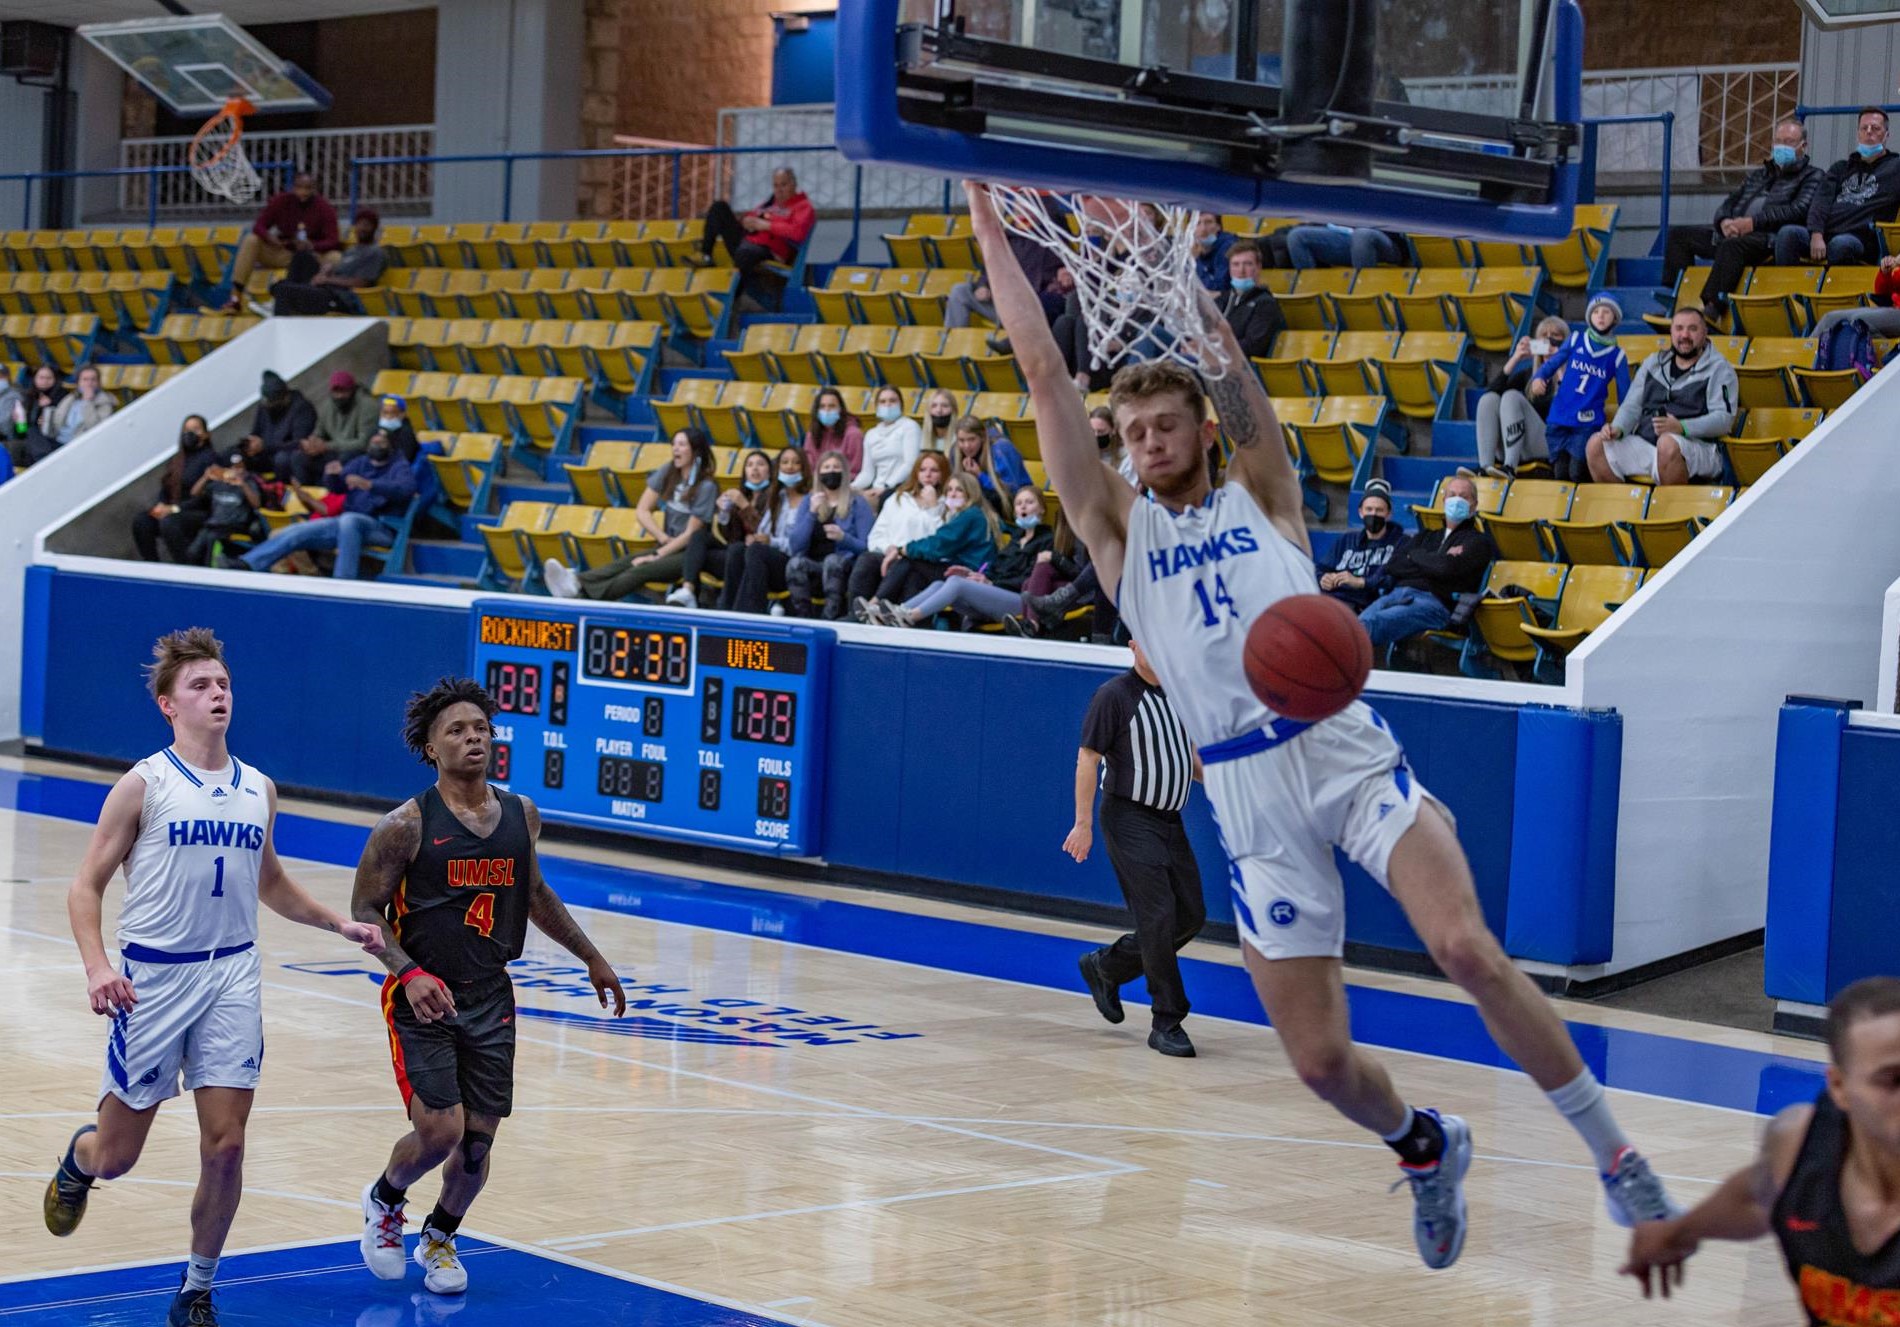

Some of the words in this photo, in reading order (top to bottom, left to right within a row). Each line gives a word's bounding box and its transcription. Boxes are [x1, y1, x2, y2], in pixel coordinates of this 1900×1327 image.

[1571, 359, 1607, 379] KANSAS
[1575, 374, 1590, 395] 1
[1148, 526, 1259, 583] HAWKS
[1193, 573, 1239, 628] 14
[481, 615, 576, 650] ROCKHURST
[726, 639, 775, 671] UMSL
[604, 704, 641, 723] PERIOD
[596, 737, 633, 756] PLAYER
[641, 743, 668, 761] FOUL
[757, 757, 792, 777] FOULS
[611, 800, 646, 818] MATCH
[168, 819, 264, 851] HAWKS
[755, 819, 790, 839] SCORE
[211, 856, 225, 897] 1
[447, 858, 515, 887] UMSL
[464, 892, 496, 938] 4
[701, 998, 926, 1040] FIELD
